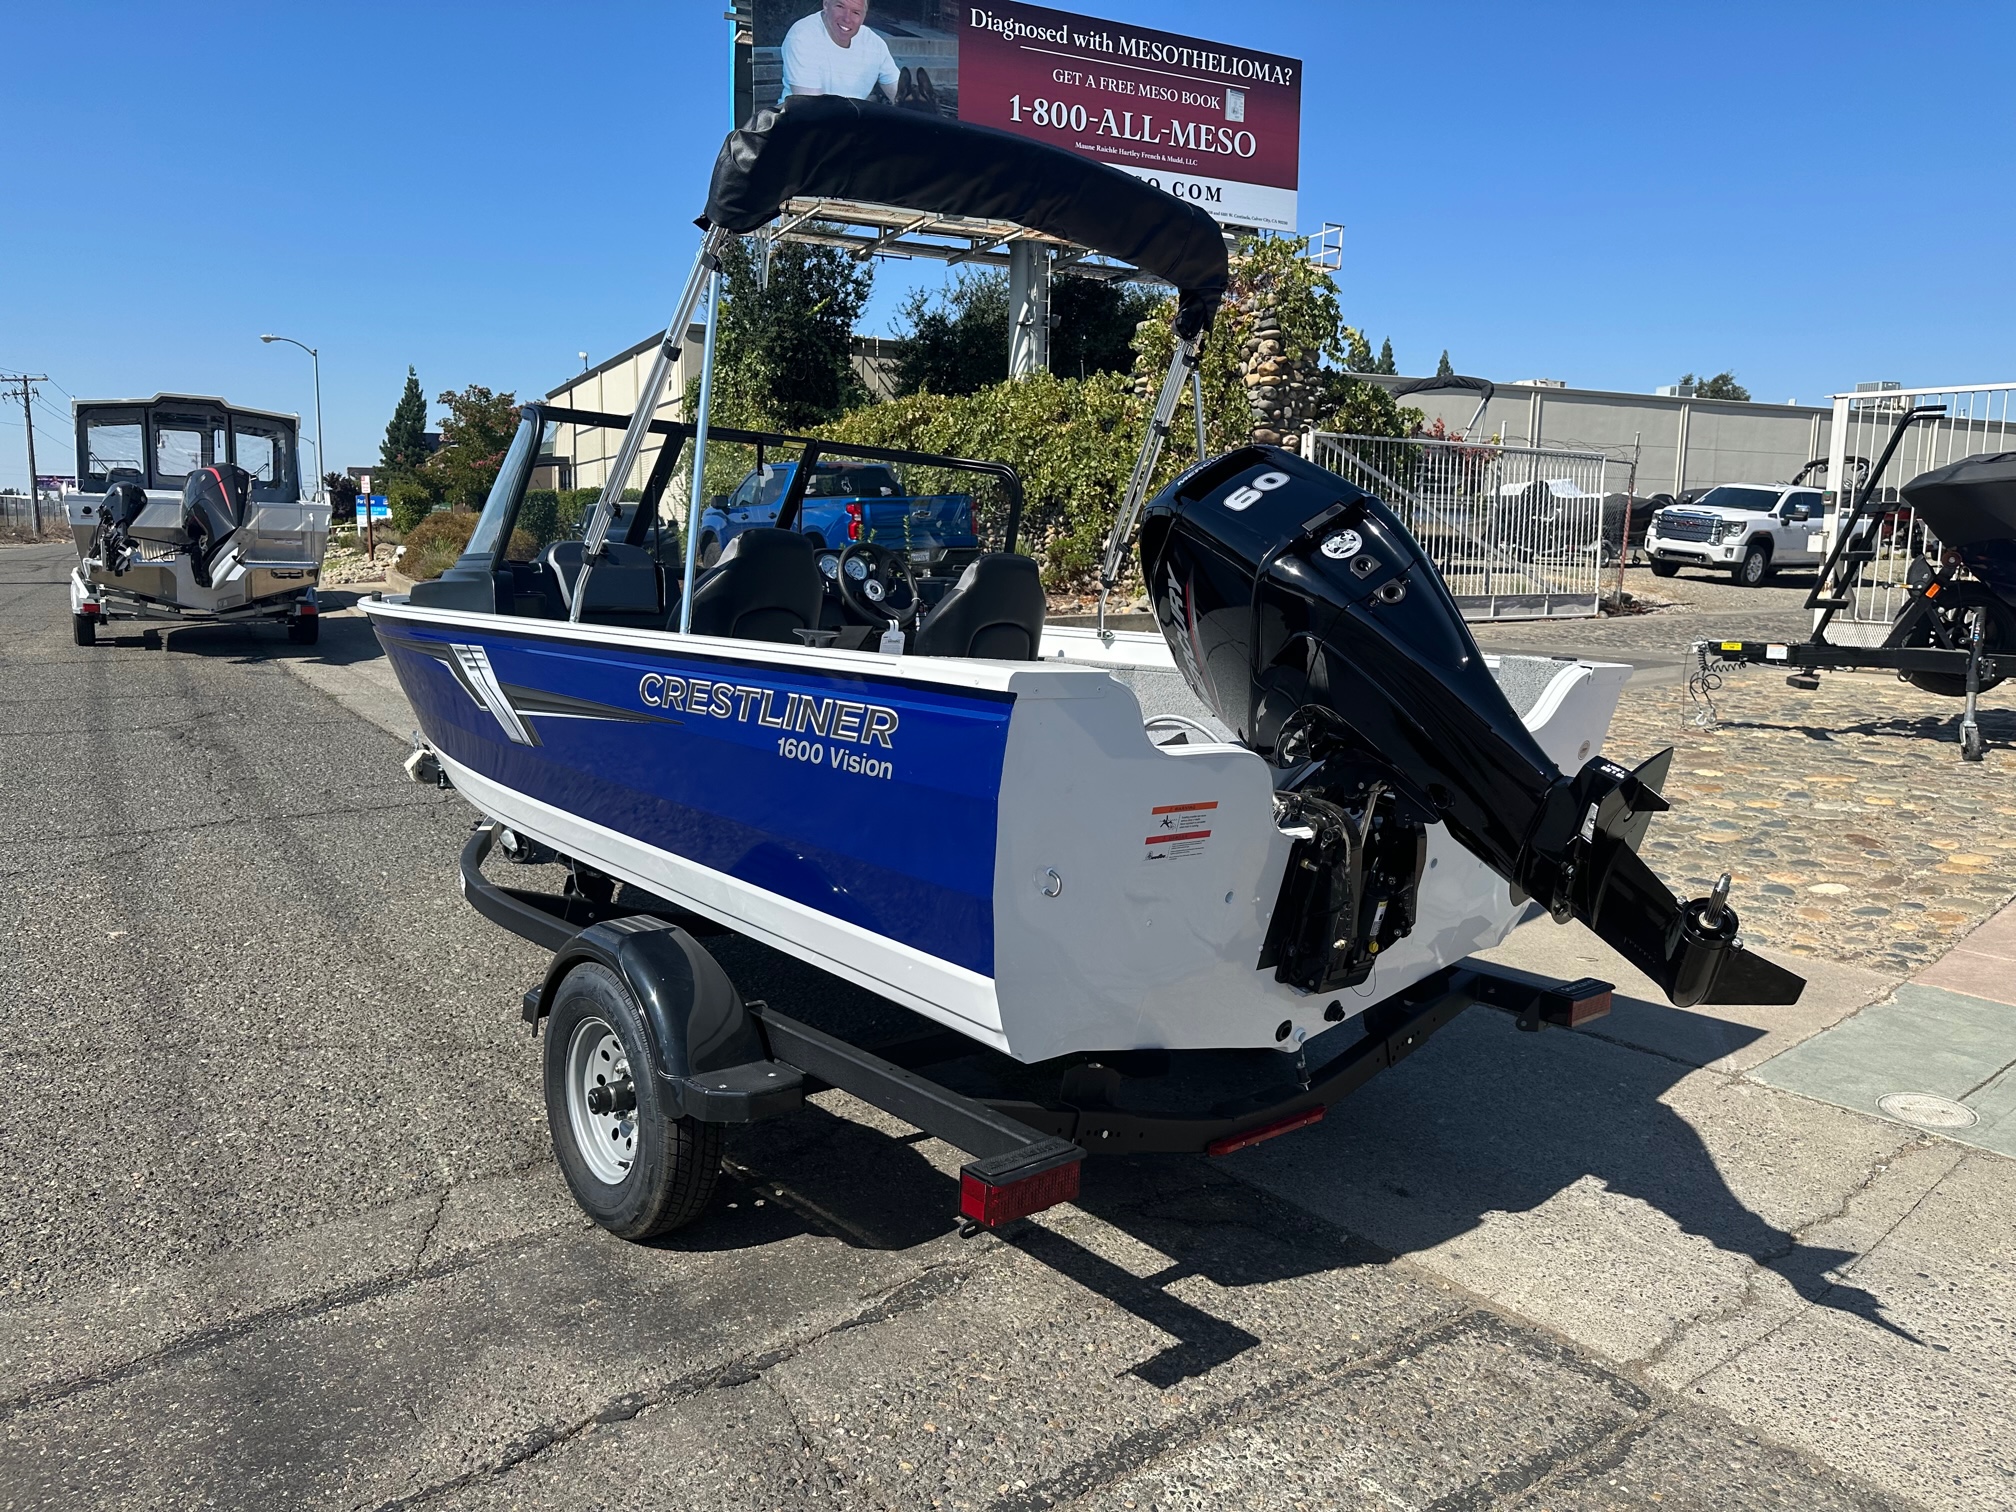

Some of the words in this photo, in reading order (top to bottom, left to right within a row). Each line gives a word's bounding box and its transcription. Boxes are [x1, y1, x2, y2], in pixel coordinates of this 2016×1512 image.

[970, 7, 1068, 44] Diagnosed
[1073, 31, 1113, 53] with
[1117, 35, 1293, 86] MESOTHELIOMA?
[1053, 69, 1082, 85] GET
[1085, 75, 1096, 89] A
[1099, 76, 1135, 95] FREE
[1138, 83, 1178, 102] MESO
[1181, 90, 1220, 110] BOOK
[1009, 94, 1257, 158] 1-800-ALL-MESO
[1075, 141, 1096, 151] Maune
[1096, 144, 1118, 154] Raichle
[1119, 147, 1140, 159] Hartley
[1141, 151, 1161, 161] French
[1185, 158, 1198, 166] LLC
[1223, 471, 1291, 512] 60
[639, 672, 899, 749] CRESTLINER
[777, 737, 824, 765] 1600
[830, 747, 893, 780] Vision
